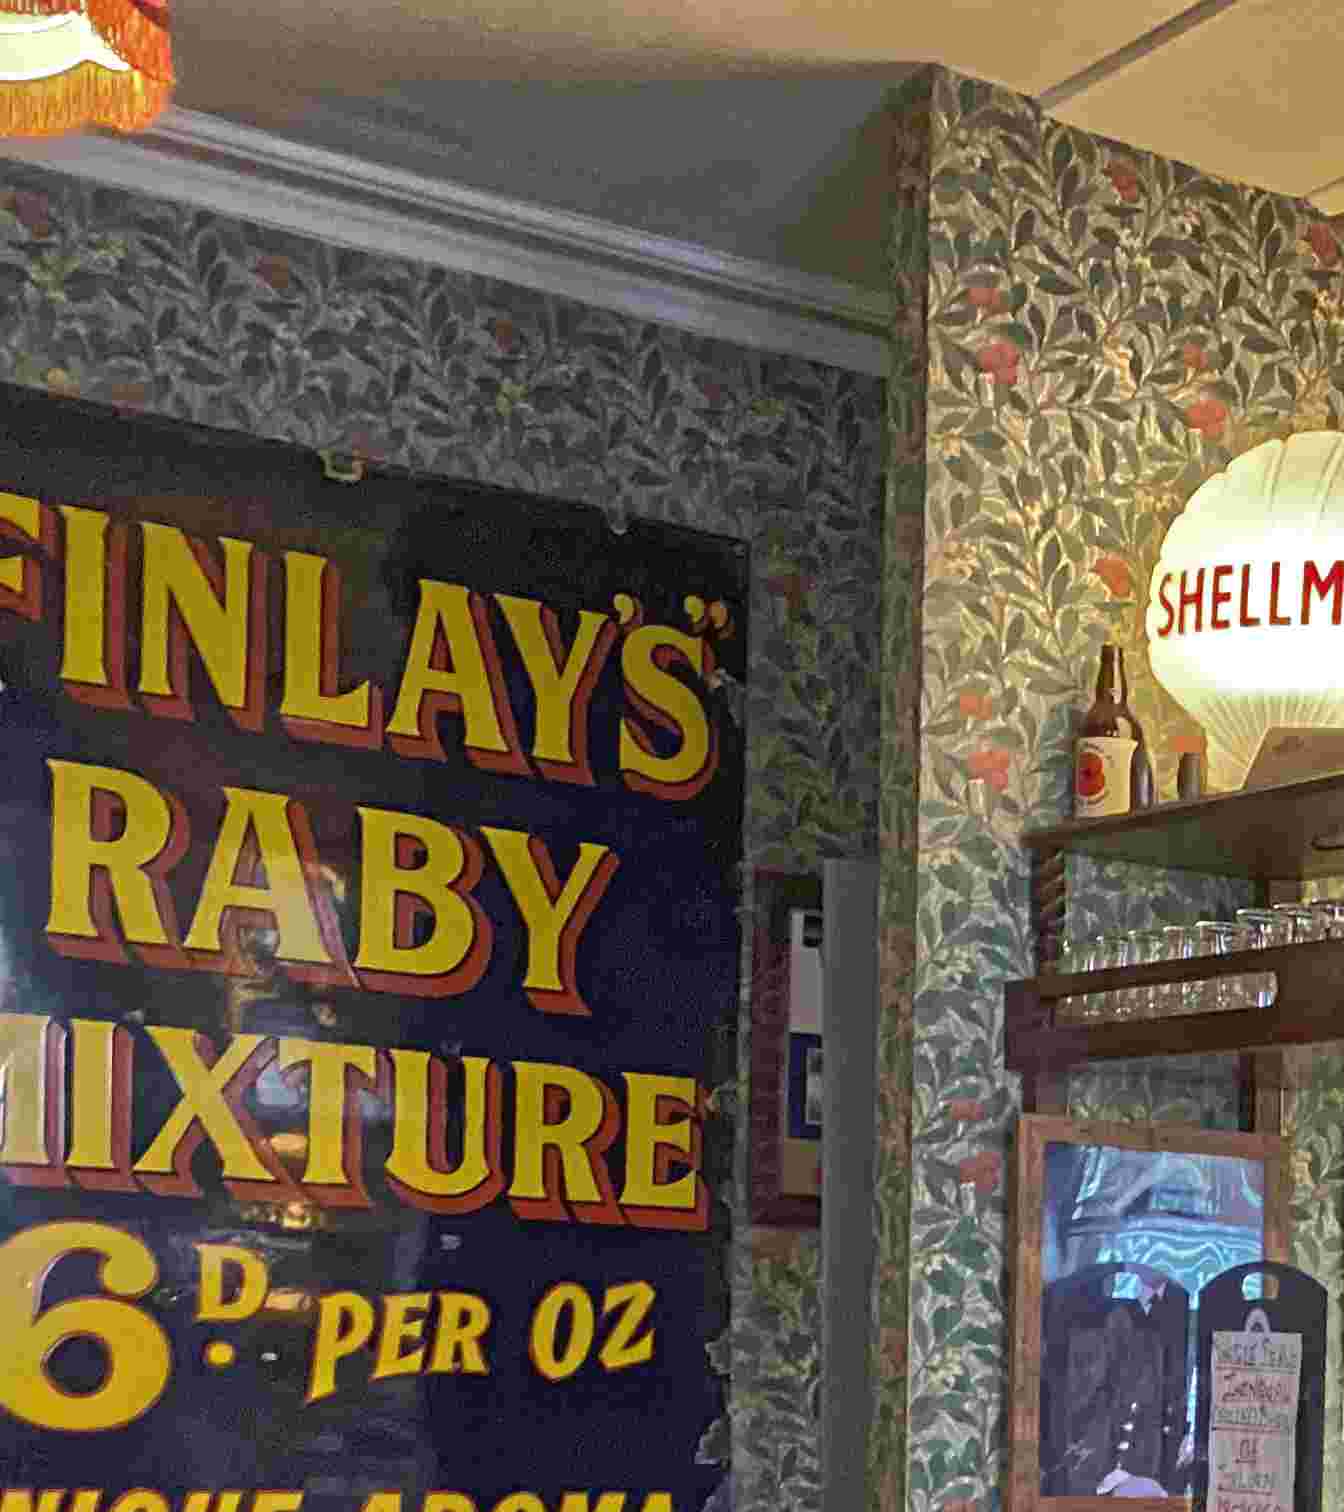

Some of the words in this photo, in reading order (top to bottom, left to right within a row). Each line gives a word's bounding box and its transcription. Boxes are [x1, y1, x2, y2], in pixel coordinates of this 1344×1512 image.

[45, 757, 613, 1005] RABY
[309, 1291, 490, 1402] PER
[531, 1280, 656, 1382] OZ
